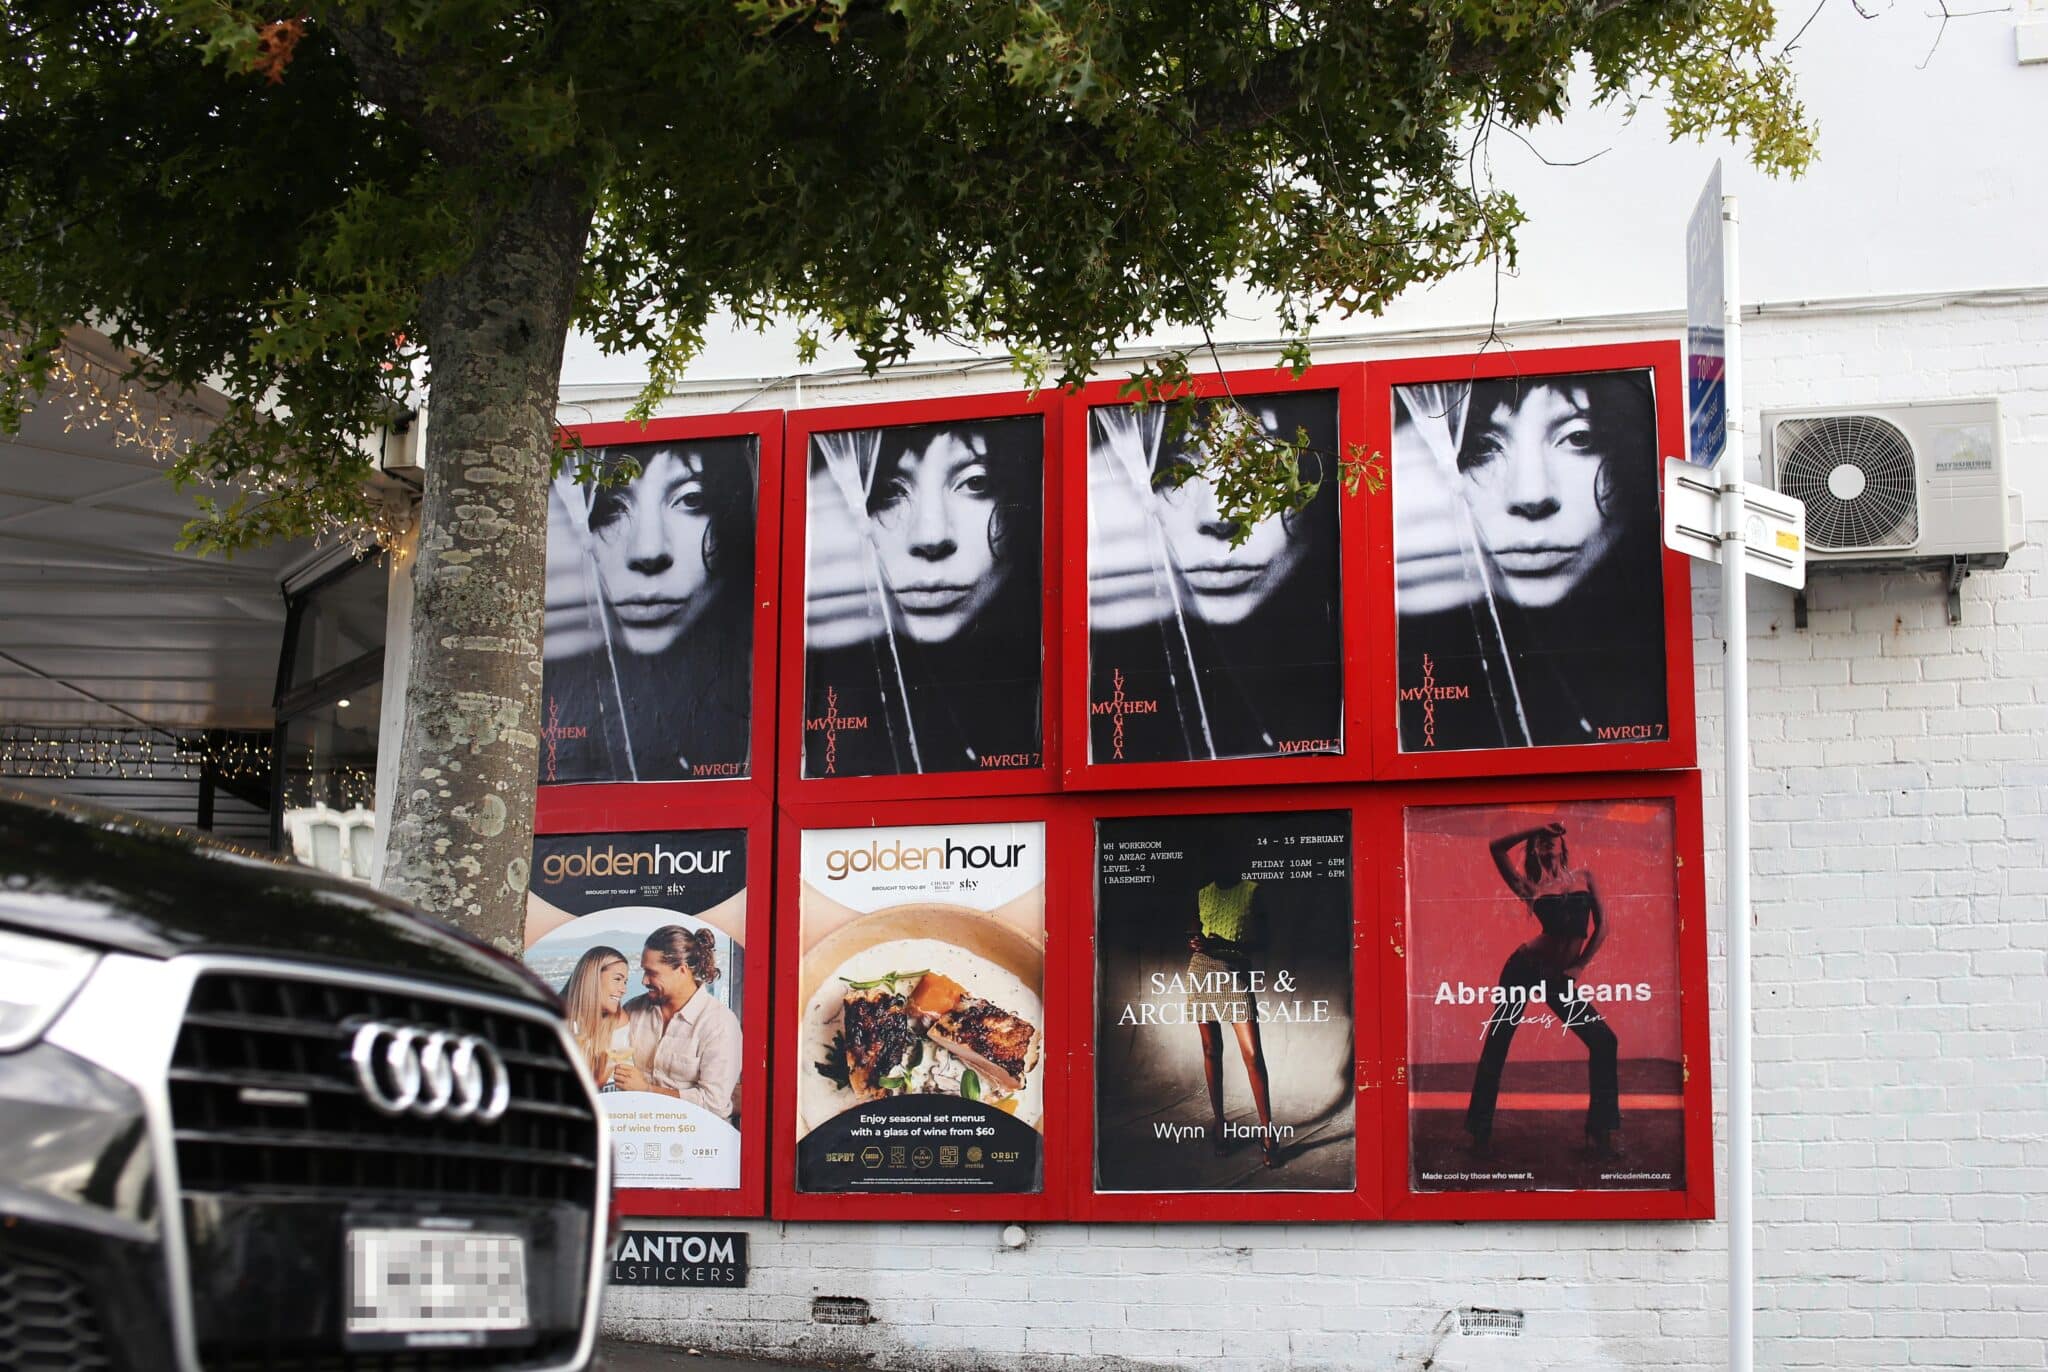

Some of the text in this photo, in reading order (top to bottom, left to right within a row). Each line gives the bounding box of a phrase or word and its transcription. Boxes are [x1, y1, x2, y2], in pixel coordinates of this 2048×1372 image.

[540, 727, 587, 739] VYHEM
[1656, 724, 1664, 737] 7
[1033, 753, 1040, 765] 7
[1119, 841, 1162, 849] WORKROOM
[1301, 835, 1344, 844] FEBRUARY
[826, 838, 1026, 880] goldenhour
[1119, 853, 1146, 861] ANZAC
[1150, 852, 1183, 860] AVENUE
[543, 843, 731, 884] goldenhour
[1103, 865, 1130, 873] LEVEL
[1252, 860, 1284, 868] FRIDAY
[1290, 859, 1312, 867] 10AM
[1328, 858, 1345, 866] 6PM
[1104, 875, 1156, 884] (BASEMENT)
[1241, 872, 1285, 880] SATURDAY
[1290, 871, 1312, 879] 10AM
[1328, 869, 1345, 878] 6PM
[960, 878, 979, 891] sky
[1151, 970, 1297, 995] SAMPLE &
[1434, 979, 1652, 1005] Abrand Jeans
[1118, 1000, 1330, 1026] ARCHIVE SALE
[1479, 1000, 1606, 1040] Alexis Ren
[860, 1114, 985, 1125] Enjoy seasonal set menus
[629, 1124, 650, 1132] wine
[654, 1124, 675, 1132] from
[678, 1124, 696, 1133] $60
[851, 1127, 873, 1136] with
[884, 1127, 908, 1138] glass
[911, 1127, 921, 1136] of
[923, 1127, 947, 1136] wine
[950, 1127, 973, 1136] from
[975, 1126, 995, 1137] $60
[1153, 1121, 1294, 1143] Wynn Hamlyn
[1460, 1173, 1468, 1181] by
[1470, 1172, 1490, 1180] those
[1491, 1172, 1507, 1180] who
[1526, 1172, 1534, 1180] it.
[1601, 1172, 1671, 1180] servicedenim.co.nz
[613, 1236, 735, 1263] ANTOM
[616, 1266, 735, 1281] LSTICKERS
